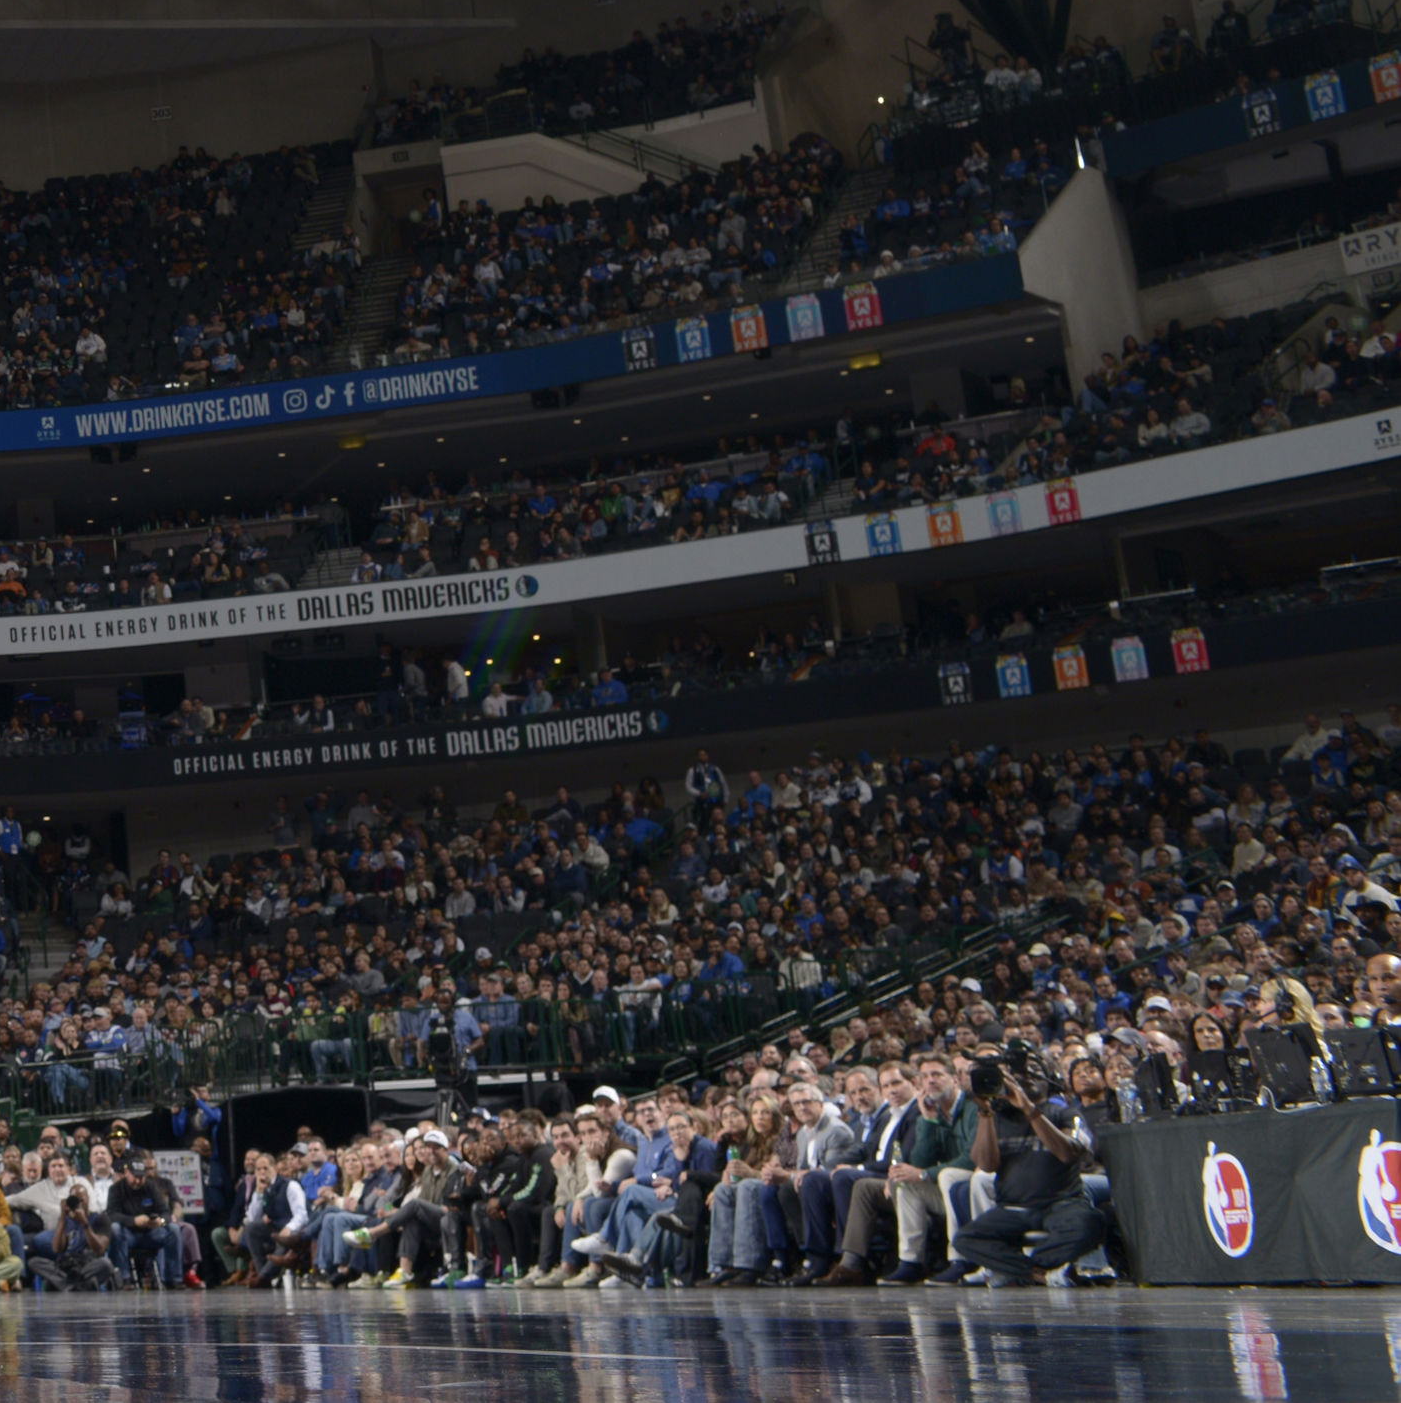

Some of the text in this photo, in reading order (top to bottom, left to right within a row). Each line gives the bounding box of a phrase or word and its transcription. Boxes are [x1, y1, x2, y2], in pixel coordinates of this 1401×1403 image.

[75, 366, 480, 438] WWW.DRINKRYSE.COM @DRINKRYSE
[9, 576, 510, 644] OFFICIAL ENERGY DRINK OF THE DALLAS MAVERICKS
[173, 711, 642, 776] OFFICIAL ENERGY DRINK OF THE DALLAS MAVERICKS
